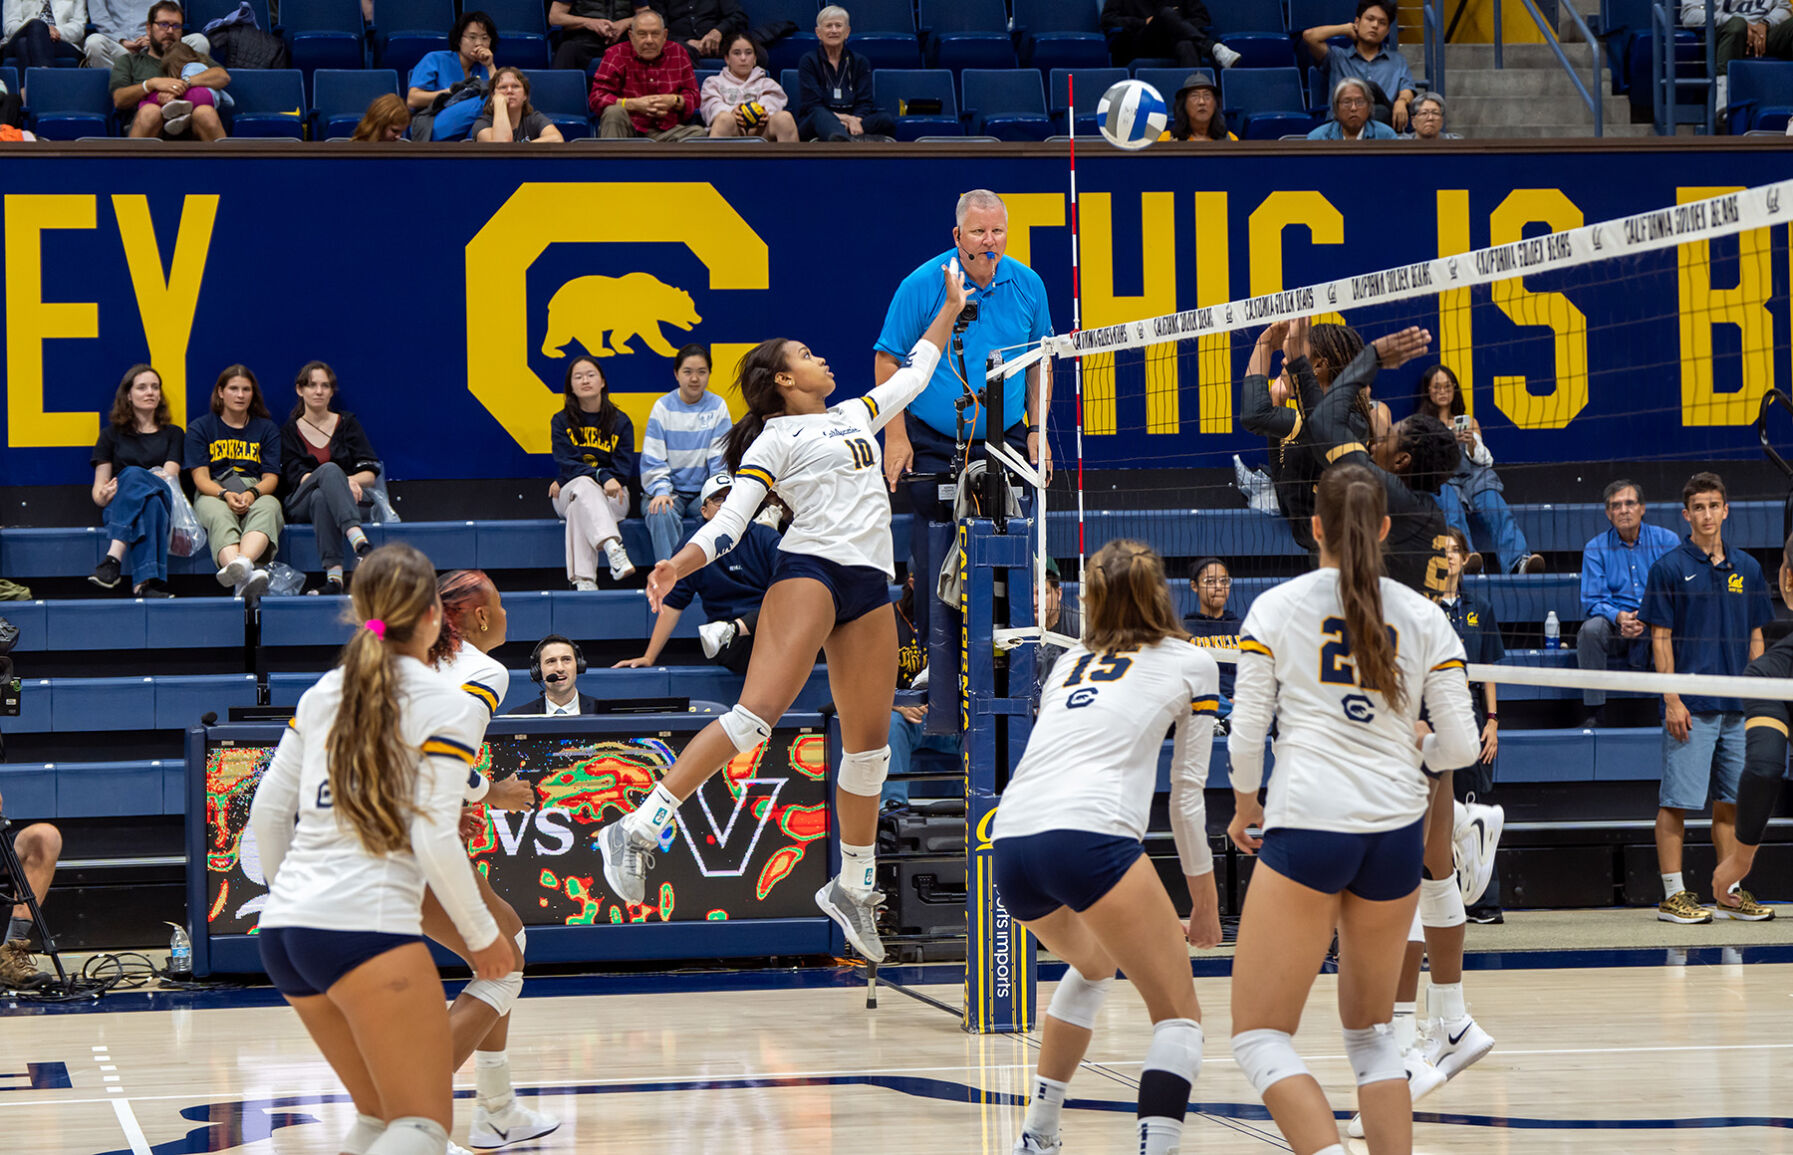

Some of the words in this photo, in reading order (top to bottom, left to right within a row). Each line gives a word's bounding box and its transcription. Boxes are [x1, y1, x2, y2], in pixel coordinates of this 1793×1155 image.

[4, 194, 220, 448] EY
[961, 190, 1346, 436] HI
[1436, 188, 1589, 430] IS
[1676, 186, 1793, 427] B
[844, 437, 875, 471] 10
[1062, 643, 1143, 688] 15
[1319, 615, 1400, 692] 2
[487, 807, 574, 856] VS
[993, 883, 1011, 928] orts
